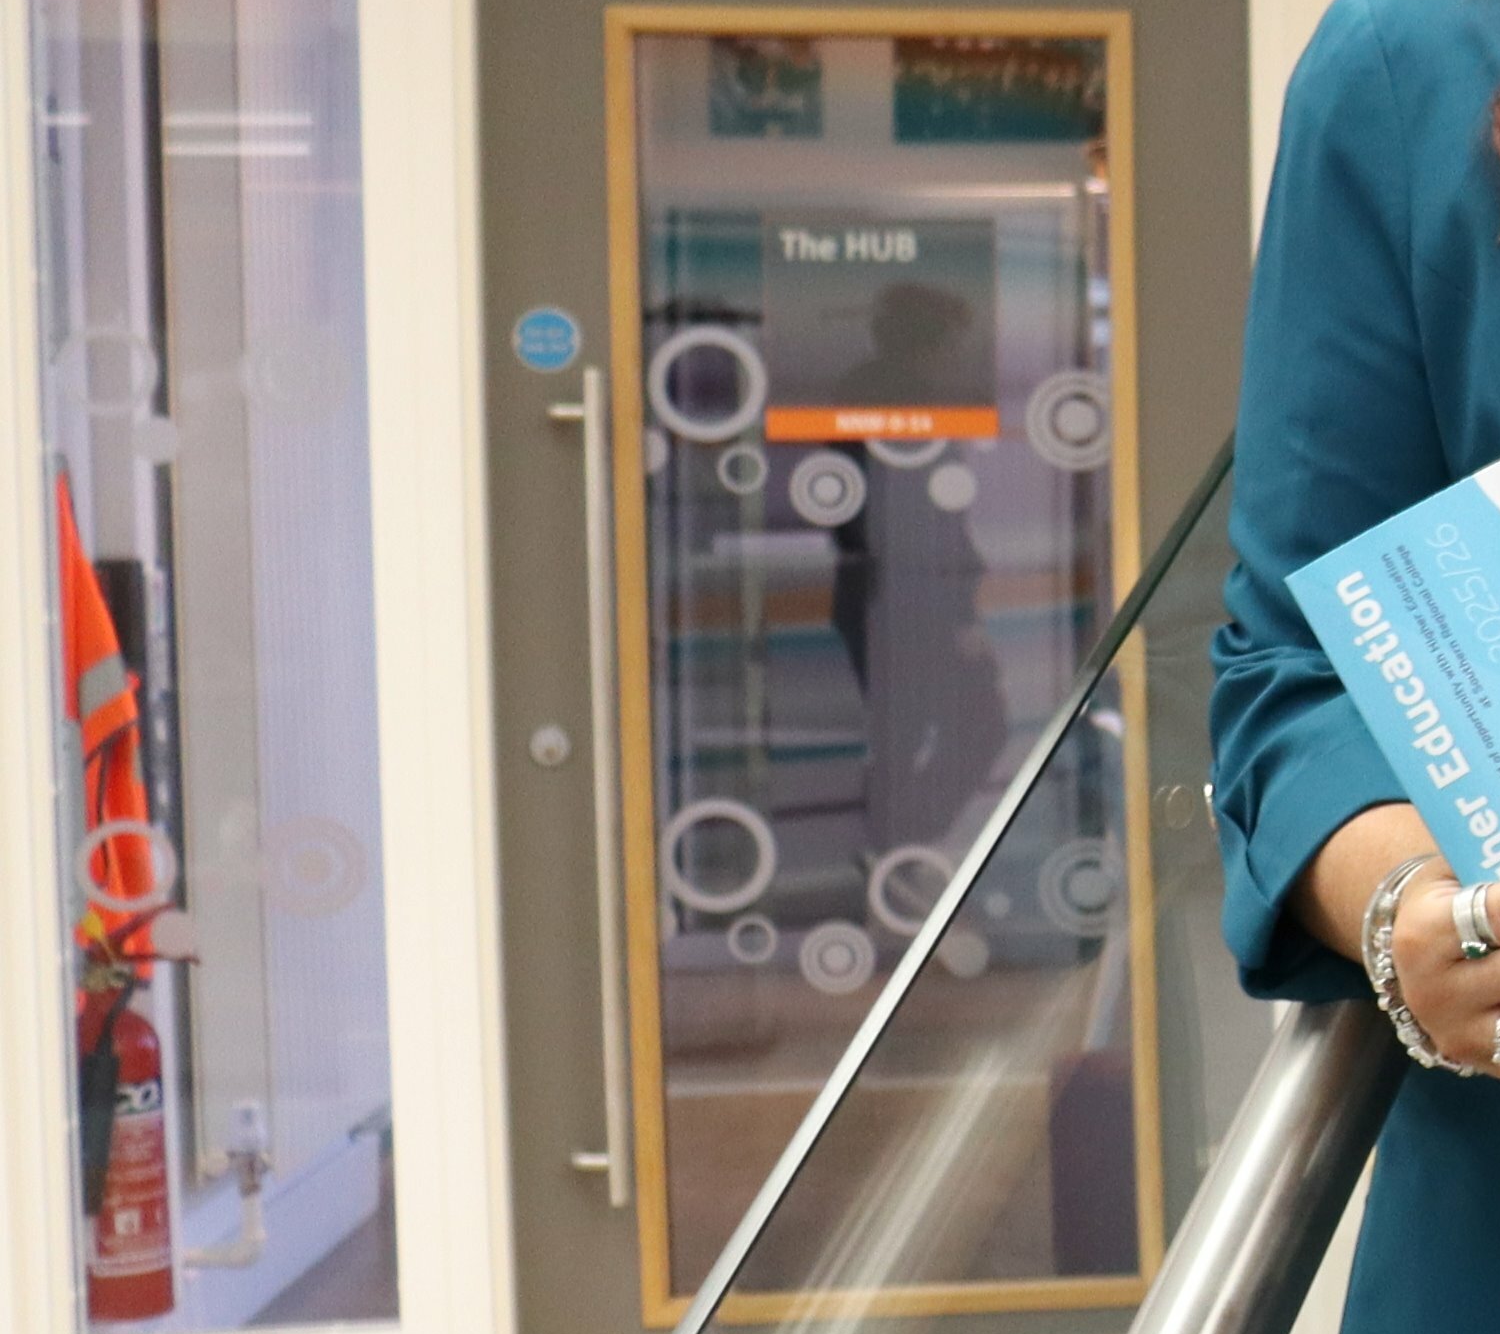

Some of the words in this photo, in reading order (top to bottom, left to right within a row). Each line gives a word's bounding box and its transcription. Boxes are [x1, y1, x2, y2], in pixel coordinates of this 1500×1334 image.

[780, 229, 838, 262] The
[845, 231, 917, 262] HUB
[1381, 553, 1417, 611] Education
[1413, 614, 1439, 652] Higher
[1336, 571, 1470, 789] Education
[1436, 653, 1454, 679] with
[1451, 682, 1493, 748] opportunity
